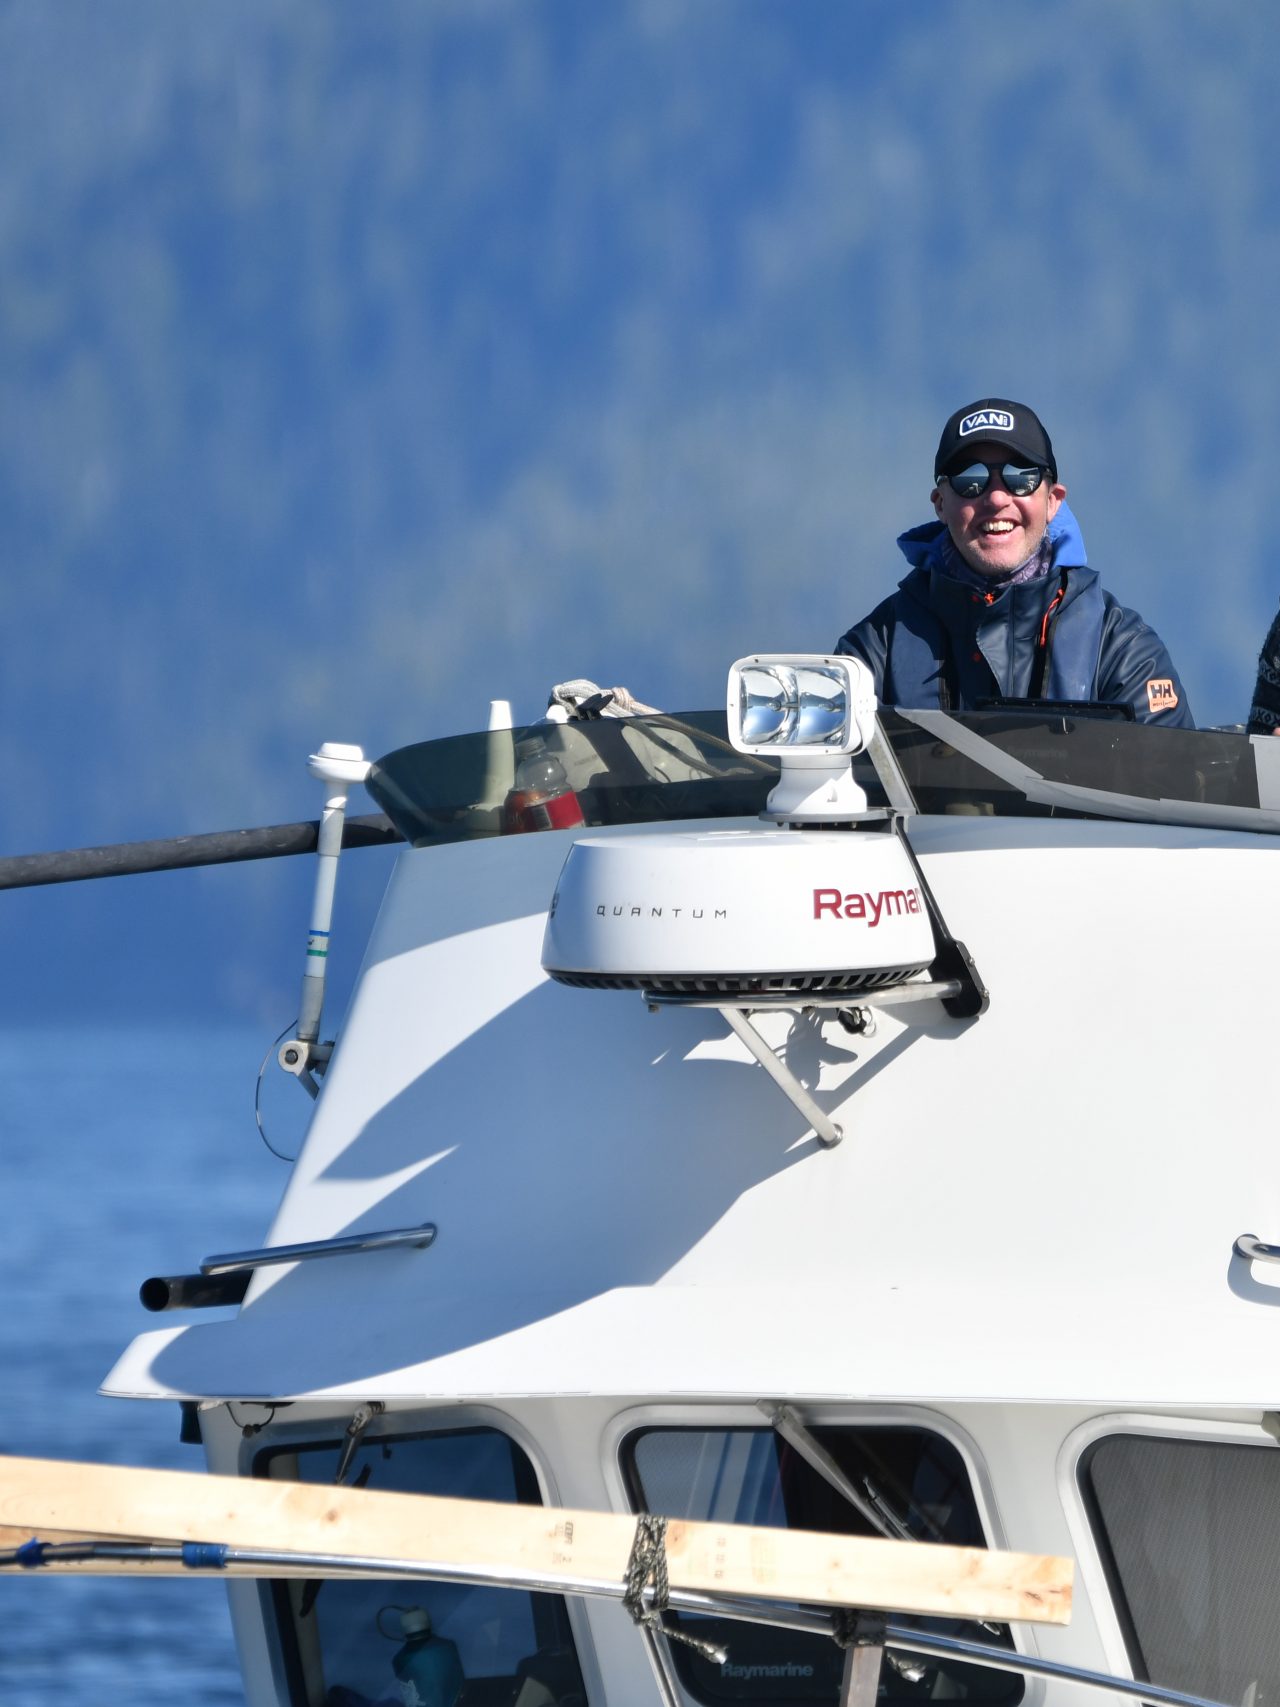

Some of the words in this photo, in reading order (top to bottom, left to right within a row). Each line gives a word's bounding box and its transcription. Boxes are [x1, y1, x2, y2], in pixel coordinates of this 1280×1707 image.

[1150, 684, 1172, 698] HH
[597, 904, 728, 919] QUANTUM
[721, 1662, 814, 1680] Raymarine
